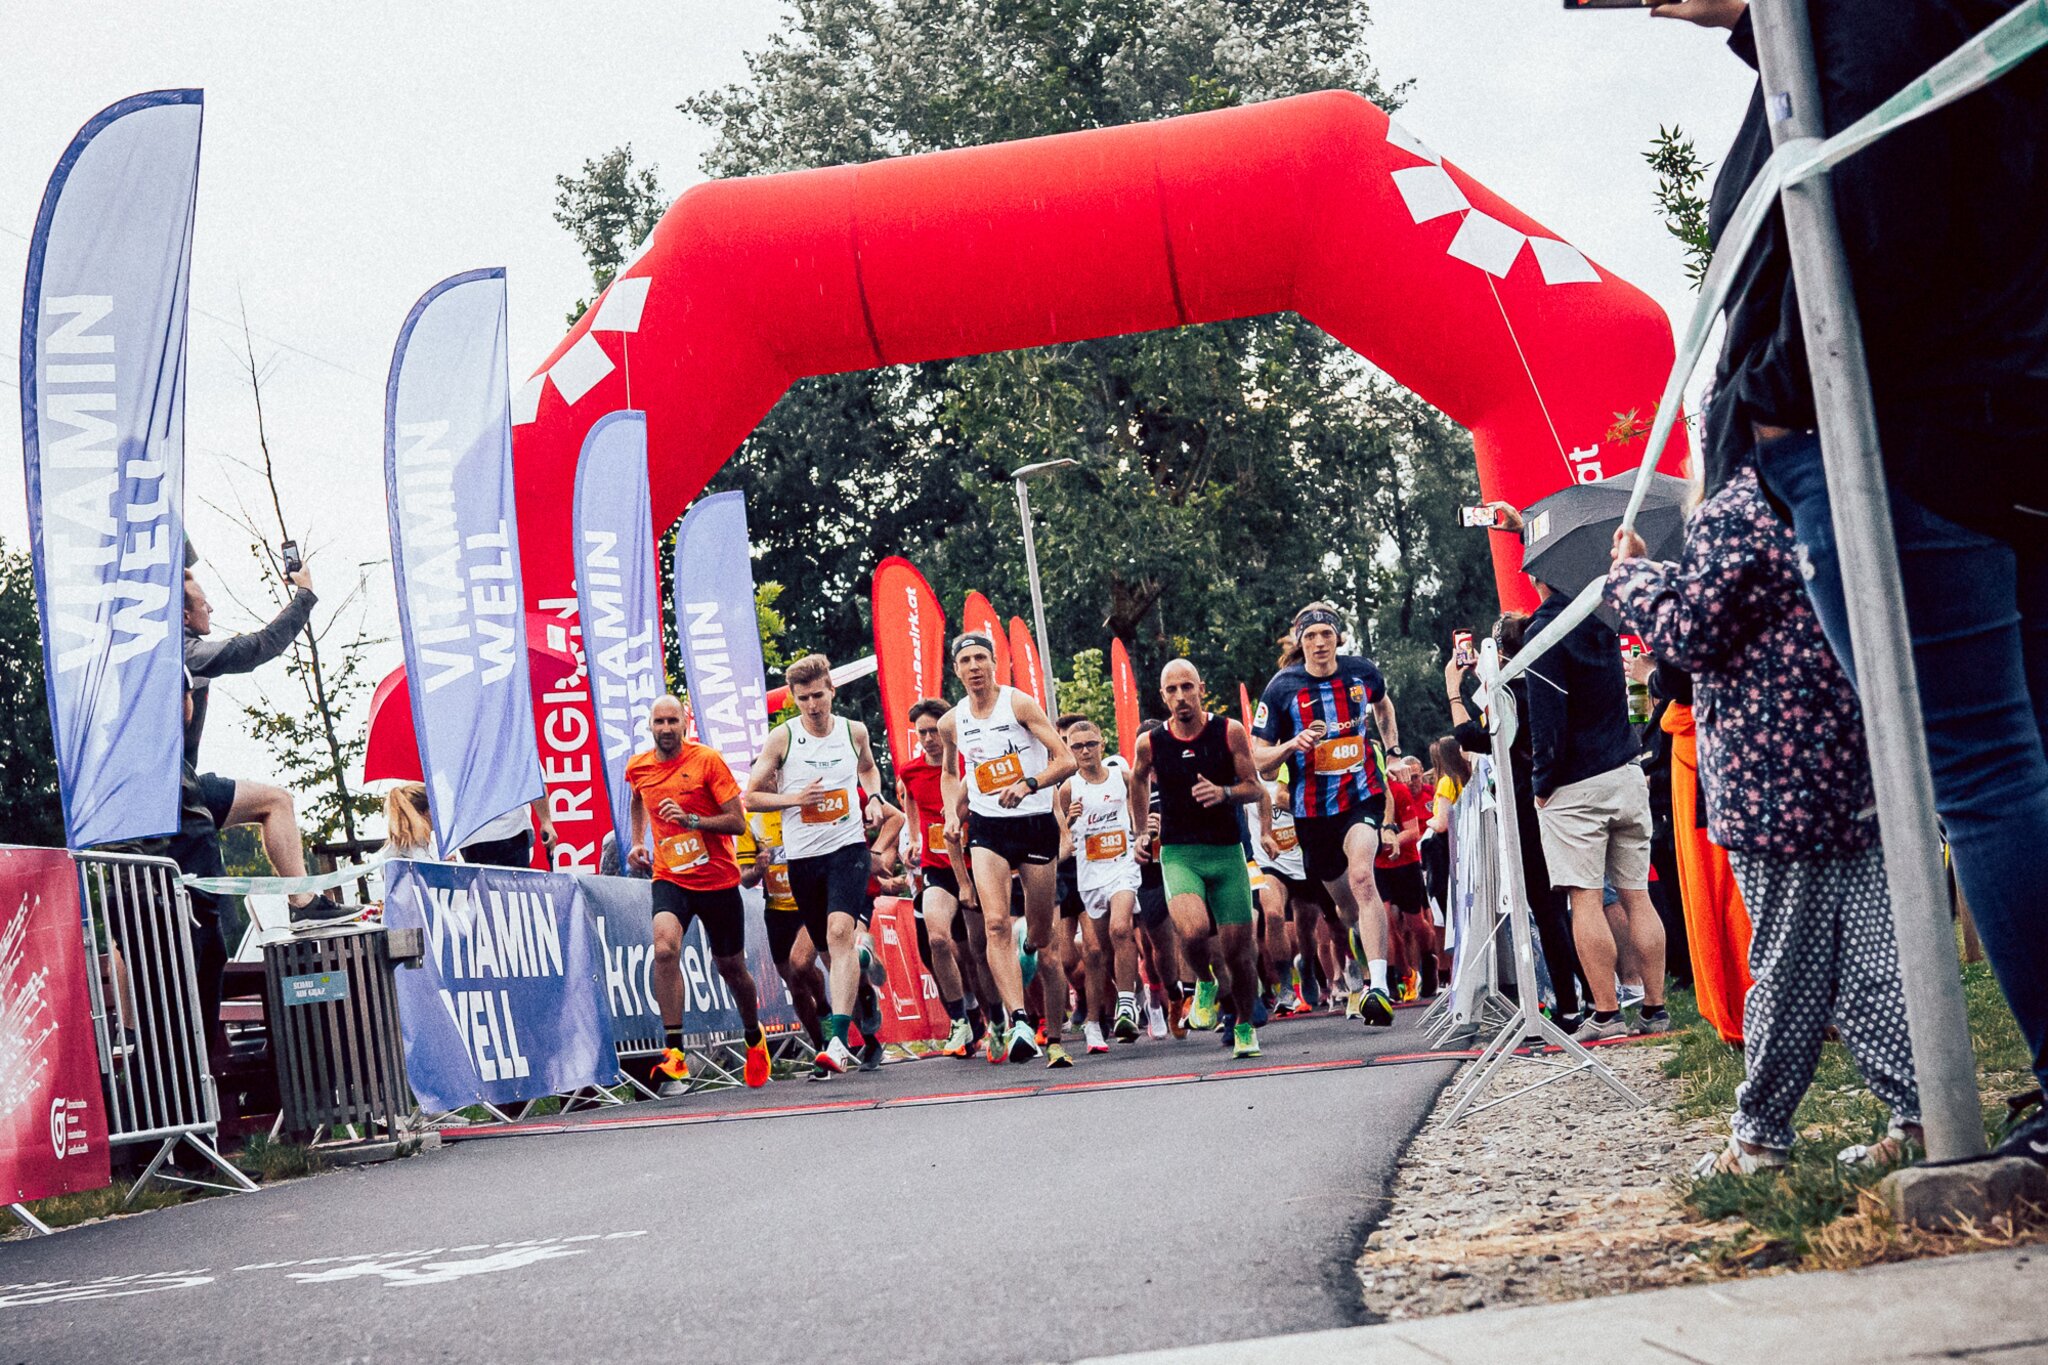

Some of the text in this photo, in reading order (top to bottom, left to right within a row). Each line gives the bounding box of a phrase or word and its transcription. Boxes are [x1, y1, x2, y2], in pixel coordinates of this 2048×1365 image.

[46, 295, 118, 673] VITAMIN
[110, 437, 170, 666] WELL
[400, 420, 474, 694] VITAMIN
[466, 519, 517, 686] WELL
[585, 530, 632, 761] VITAMIN
[741, 677, 769, 762] ELL
[1331, 743, 1359, 760] 480
[817, 797, 844, 813] 524
[987, 758, 1014, 777] 191
[674, 838, 700, 856] 512
[1100, 834, 1122, 848] 383
